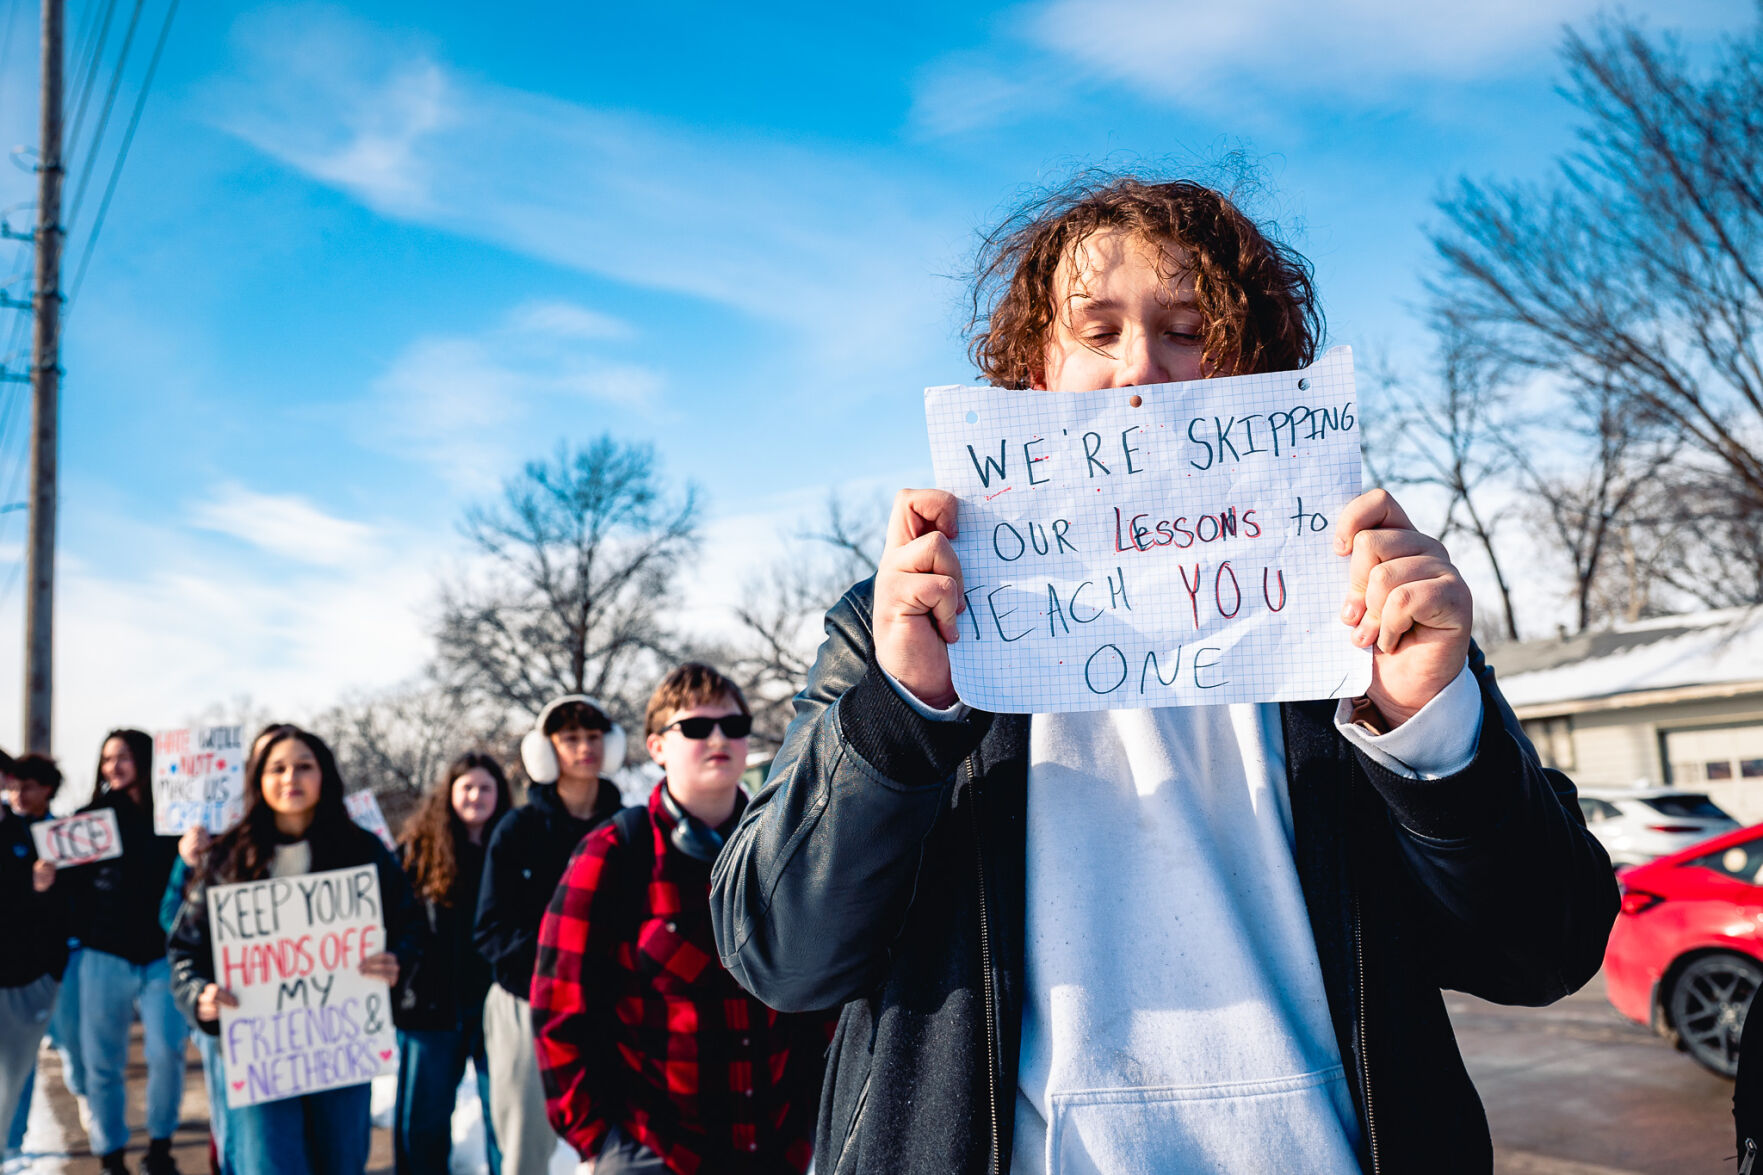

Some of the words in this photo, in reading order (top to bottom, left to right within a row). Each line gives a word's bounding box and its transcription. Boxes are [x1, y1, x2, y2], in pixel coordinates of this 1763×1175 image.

[966, 426, 1145, 489] WE'RE
[1187, 402, 1355, 471] SKIPPING
[993, 518, 1079, 562] OUR
[1291, 496, 1329, 536] to
[963, 566, 1132, 643] TEACH
[1178, 560, 1287, 630] YOU
[1084, 645, 1230, 695] ONE
[52, 818, 105, 859] ICE
[213, 880, 292, 941] KEEP
[298, 871, 377, 926] YOUR
[221, 934, 315, 990] HANDS
[320, 925, 377, 972] OFF
[277, 974, 334, 1010] MY
[228, 998, 360, 1066] FRIENDS
[364, 993, 384, 1035] &
